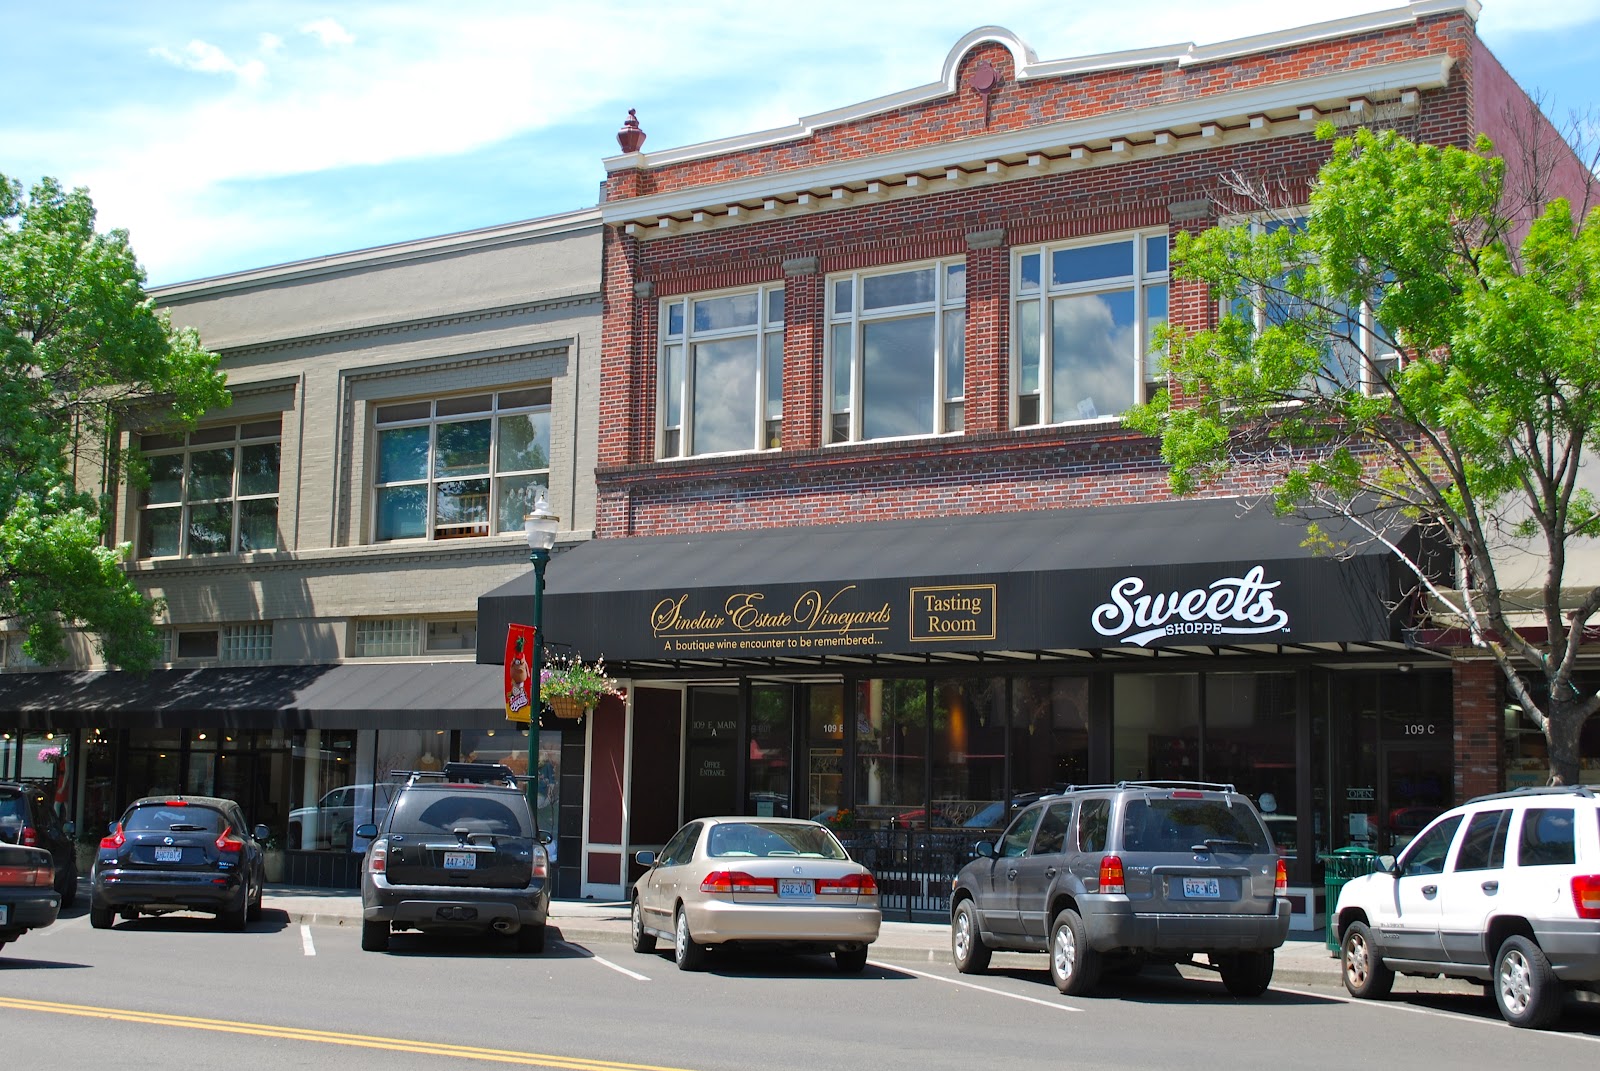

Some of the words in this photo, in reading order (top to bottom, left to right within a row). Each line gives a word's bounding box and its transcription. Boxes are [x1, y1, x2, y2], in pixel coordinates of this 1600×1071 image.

[924, 593, 982, 614] Tasting
[1091, 565, 1288, 640] Sweets
[650, 593, 725, 638] Sinclair
[725, 591, 793, 632] Estate
[792, 584, 892, 635] Vineyards
[928, 616, 977, 633] Room
[1165, 622, 1222, 635] SHOPPE
[664, 640, 672, 651] A
[676, 638, 715, 652] boutique
[716, 638, 738, 650] wine
[739, 637, 786, 649] encounter
[787, 637, 798, 648] to
[799, 636, 812, 647] be
[813, 634, 884, 646] remembered...
[693, 721, 705, 730] 109
[717, 721, 737, 730] MAIN
[823, 724, 837, 733] 109
[1404, 724, 1425, 735] 109
[1427, 724, 1435, 735] C
[711, 728, 717, 737] A
[1348, 790, 1373, 799] OPEN
